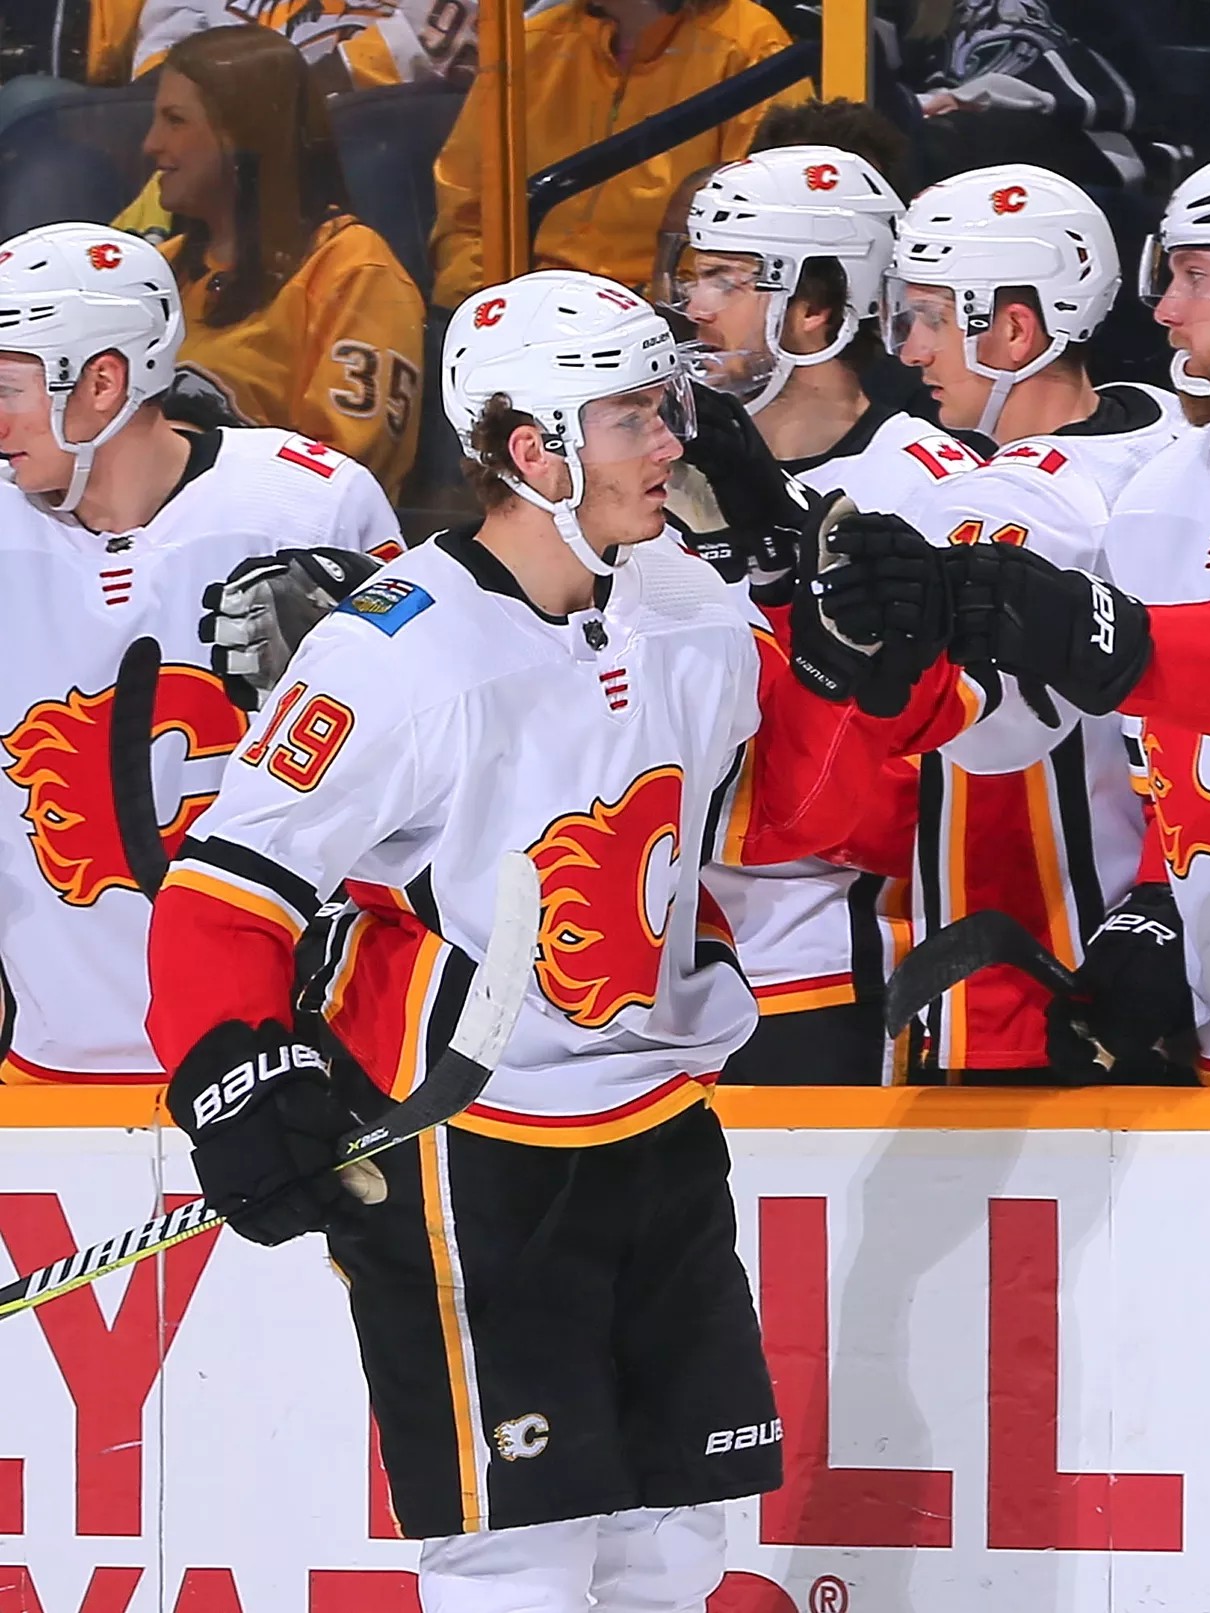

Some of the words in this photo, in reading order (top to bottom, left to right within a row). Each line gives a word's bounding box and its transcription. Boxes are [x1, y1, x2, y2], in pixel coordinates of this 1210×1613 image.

[328, 340, 421, 440] 35
[240, 681, 355, 793] 19
[192, 1043, 332, 1130] BAUE
[25, 1197, 217, 1302] WARR
